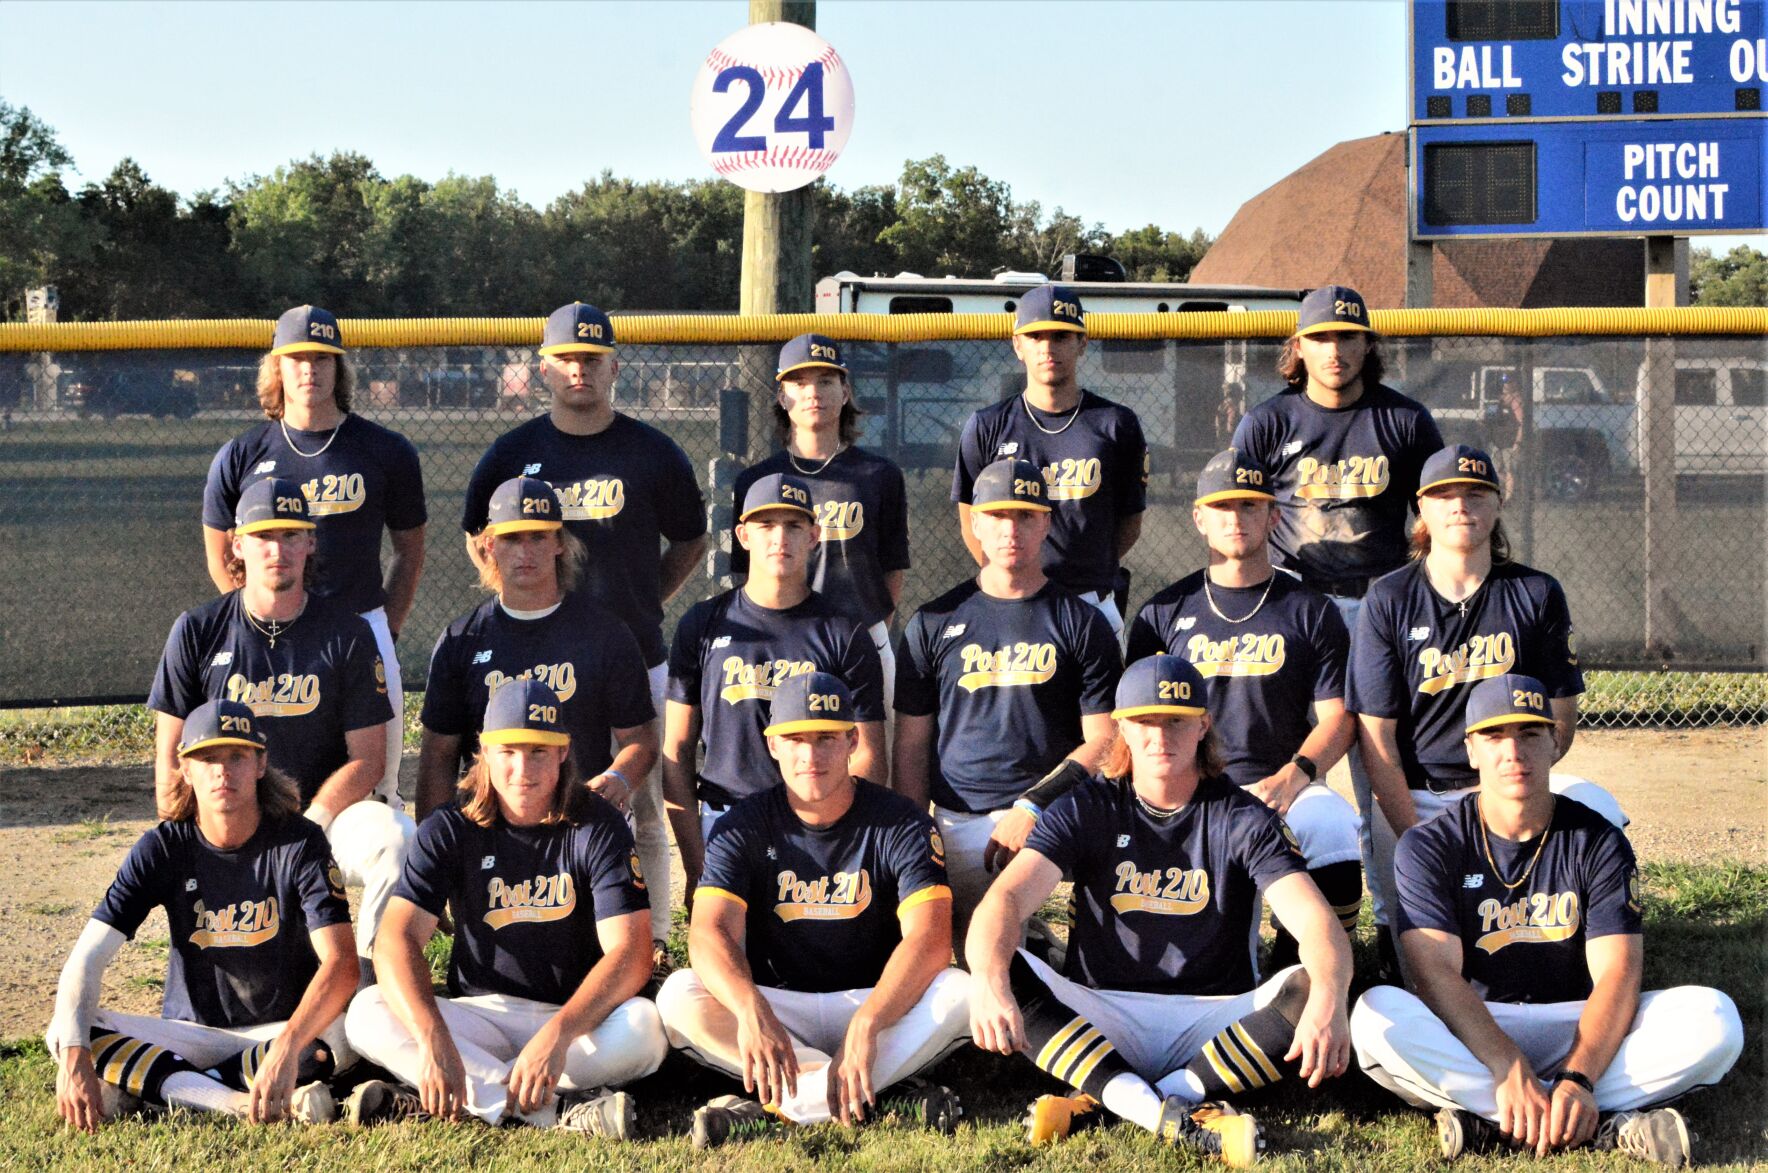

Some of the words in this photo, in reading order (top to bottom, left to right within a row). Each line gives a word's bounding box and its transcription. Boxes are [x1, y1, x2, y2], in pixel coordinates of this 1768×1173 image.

[1604, 0, 1740, 35] INNING
[1434, 45, 1522, 90] BALL
[1562, 40, 1694, 87] STRIKE
[711, 62, 835, 153] 24
[1624, 142, 1719, 180] PITCH
[1616, 184, 1729, 222] COUNT
[1053, 301, 1077, 317] 210
[1335, 300, 1360, 318] 210
[310, 322, 334, 339] 210
[578, 323, 602, 339] 210
[811, 344, 835, 360] 210
[1059, 458, 1101, 486] 210
[1236, 468, 1263, 485] 210
[1297, 457, 1347, 485] Post
[1346, 456, 1389, 484] 210
[1458, 457, 1487, 474] 210
[322, 473, 365, 500] 210
[582, 479, 624, 506] 210
[782, 485, 806, 504] 210
[1014, 480, 1040, 496] 210
[277, 497, 302, 513] 210
[523, 498, 550, 514] 210
[821, 500, 863, 528] 210
[961, 643, 1011, 672] Post
[1010, 642, 1057, 671] 210
[1188, 634, 1240, 663] Post
[1239, 633, 1285, 662] 210
[1419, 643, 1468, 678] Post
[1469, 632, 1514, 665] 210
[723, 656, 772, 686] Post
[227, 674, 275, 703] Post
[274, 673, 320, 703] 210
[1159, 681, 1191, 699] 210
[1513, 690, 1543, 710] 210
[529, 704, 556, 723] 210
[809, 694, 840, 712] 210
[221, 716, 250, 732] 210
[487, 877, 534, 908] Post
[532, 873, 576, 906] 210
[777, 870, 830, 903] Post
[830, 869, 870, 903] 210
[1162, 867, 1208, 900] 210
[238, 897, 278, 931] 210
[803, 906, 841, 916] BASEBALL
[1478, 898, 1529, 931] Post
[1528, 891, 1579, 926] 210
